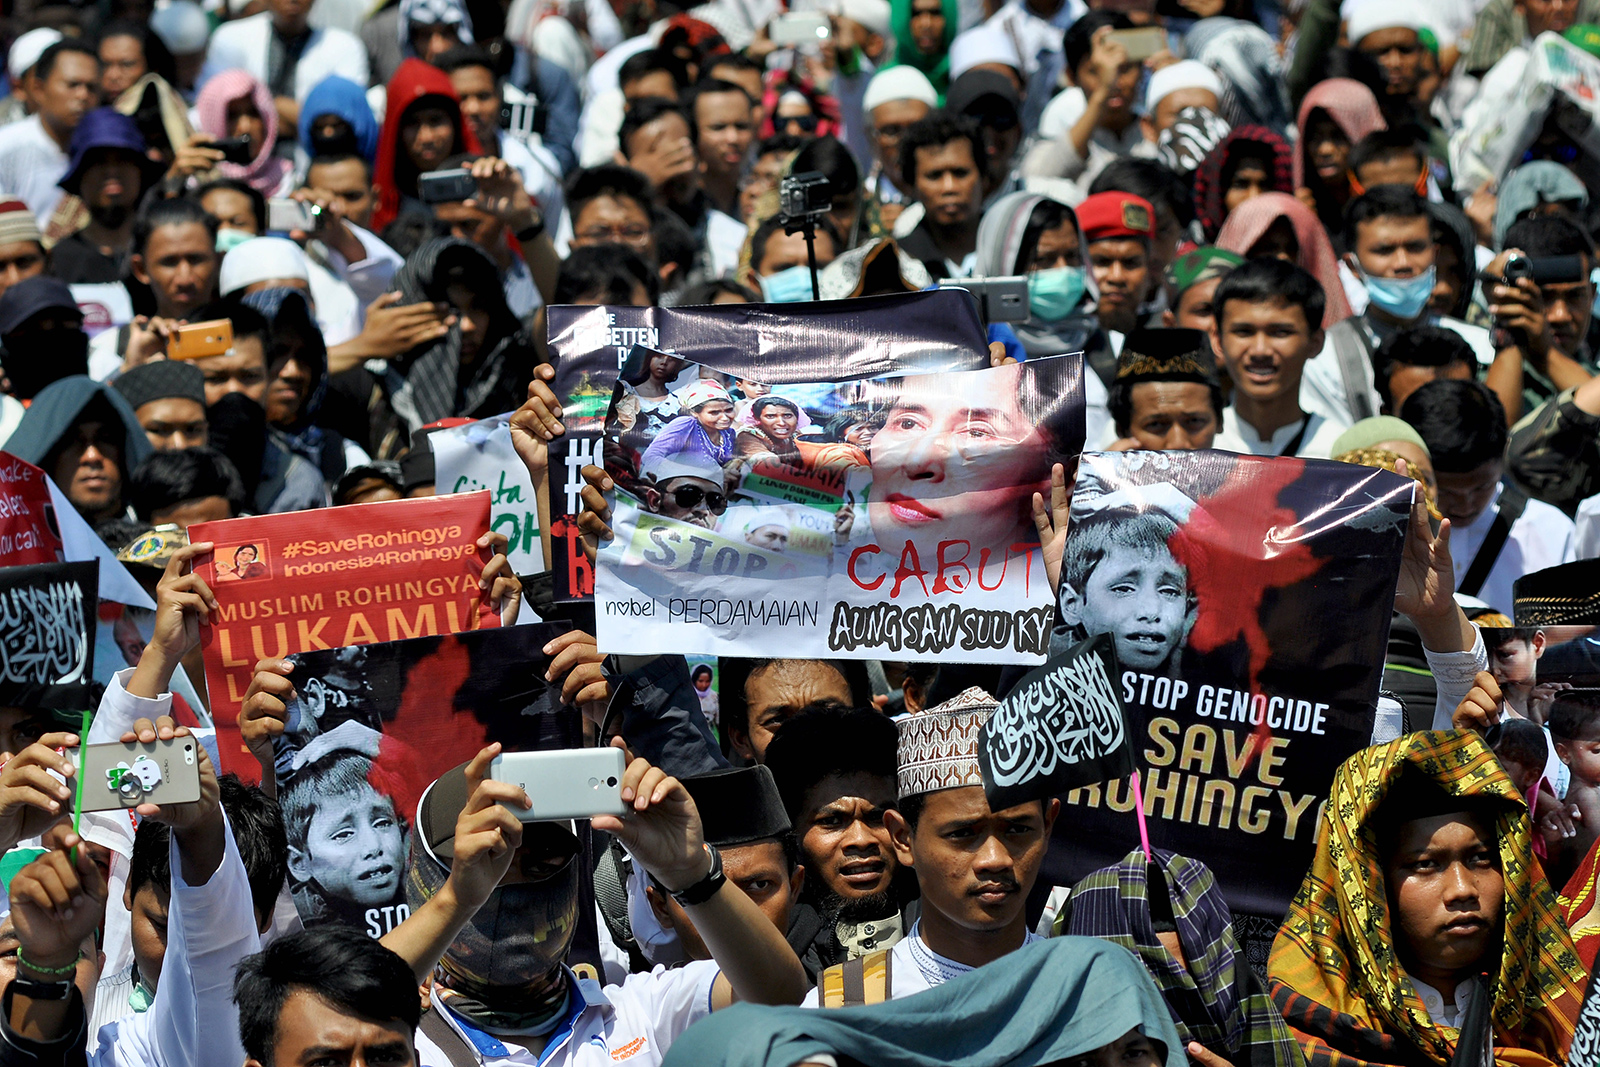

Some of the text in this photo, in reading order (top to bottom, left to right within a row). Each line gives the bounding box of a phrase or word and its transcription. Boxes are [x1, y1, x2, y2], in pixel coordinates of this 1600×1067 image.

[282, 525, 461, 559] #SaveRohingya
[284, 543, 475, 577] Indonesia4Rohingya
[643, 526, 768, 579] STOP
[847, 539, 1043, 598] CABUT
[219, 573, 479, 622] MUSLIM ROHINGYA
[668, 598, 819, 627] PERDAMAIAN
[828, 601, 1056, 656] AUNG SAN SUU KY
[1121, 671, 1330, 736] STOP GENOCIDE
[1144, 717, 1291, 787] SAVE
[364, 903, 411, 940] STO
